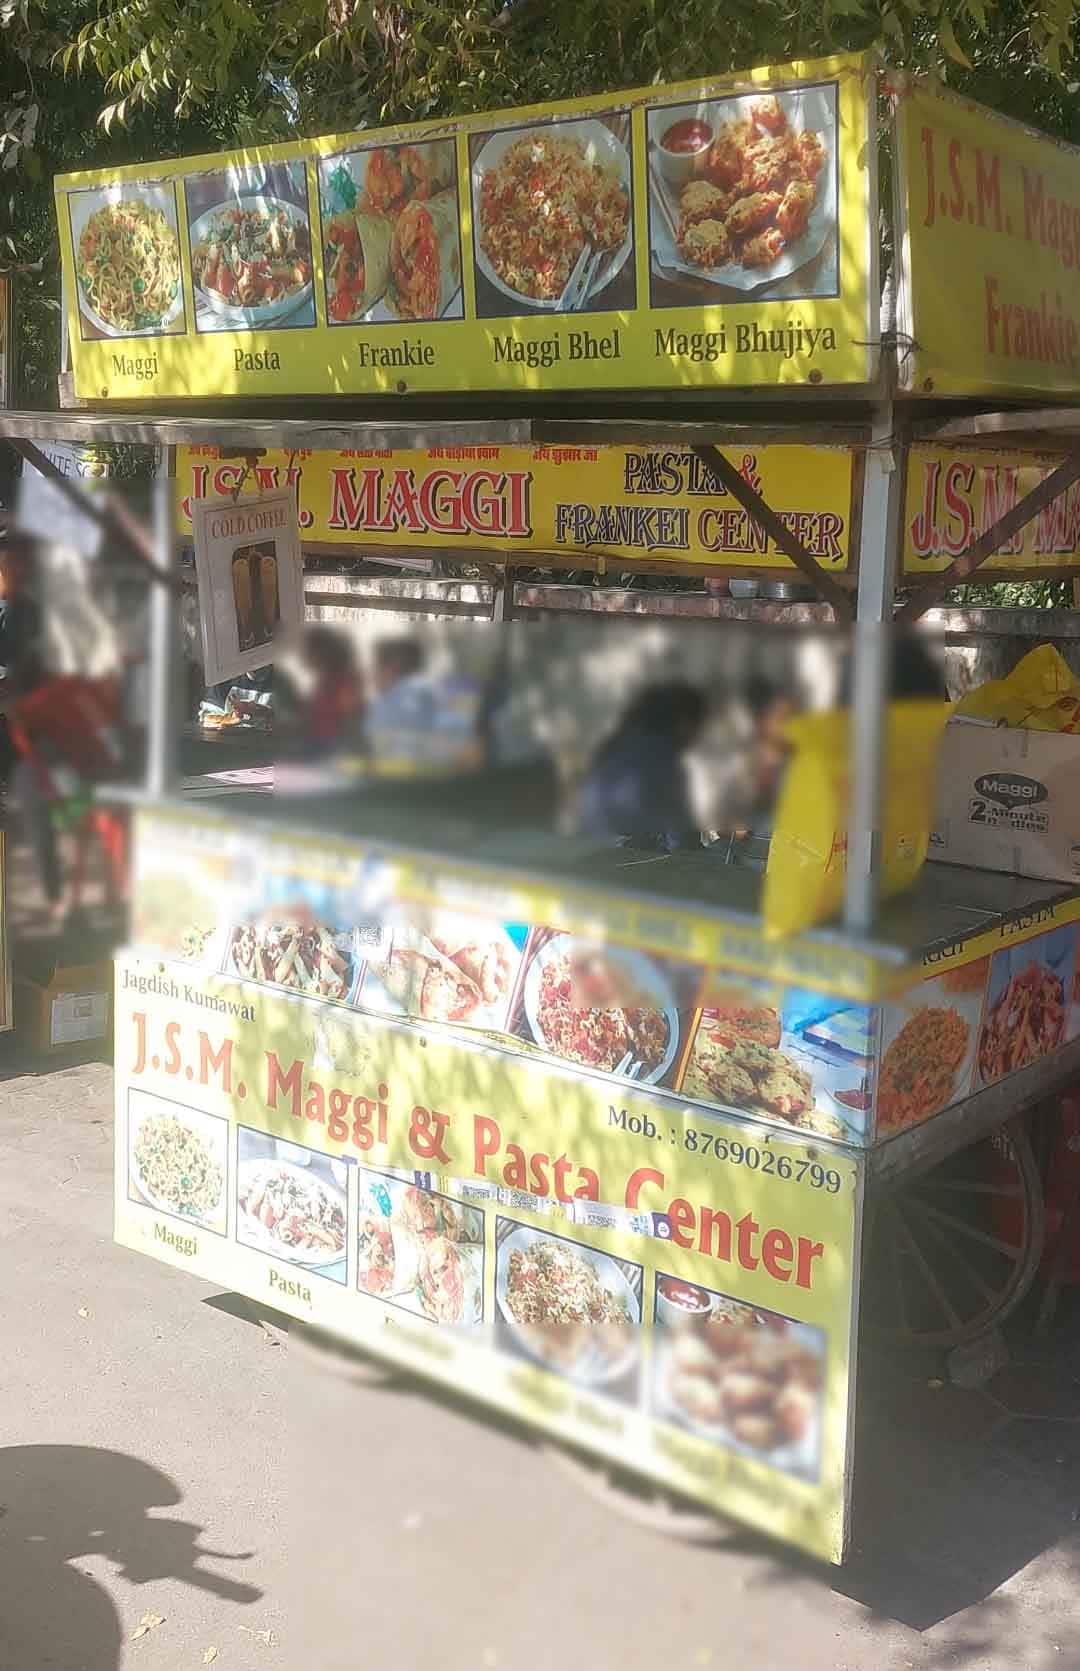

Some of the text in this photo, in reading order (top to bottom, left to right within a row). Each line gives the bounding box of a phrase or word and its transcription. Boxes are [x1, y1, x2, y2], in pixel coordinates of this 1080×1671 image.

[920, 126, 1012, 236] J.S.M.
[234, 347, 281, 372] Pasta
[359, 337, 435, 367] Frankie
[493, 328, 621, 366] Maggi Bhel
[655, 321, 837, 361] Maggi Bhujiya
[113, 352, 158, 381] Maggi
[328, 464, 532, 538] MAGGI
[212, 515, 246, 537] COLD
[554, 503, 690, 550] FRANKEI
[982, 778, 1039, 799] Maggi
[122, 969, 256, 1022] Jagdish Kumawat
[131, 1011, 247, 1098] J.S.M.
[264, 1050, 389, 1151] Maggi
[409, 1105, 451, 1165] &
[473, 1114, 600, 1204] Pasta
[684, 1129, 842, 1195] 8769026799
[153, 1220, 199, 1257] Maggi
[268, 1268, 313, 1303] Pasta
